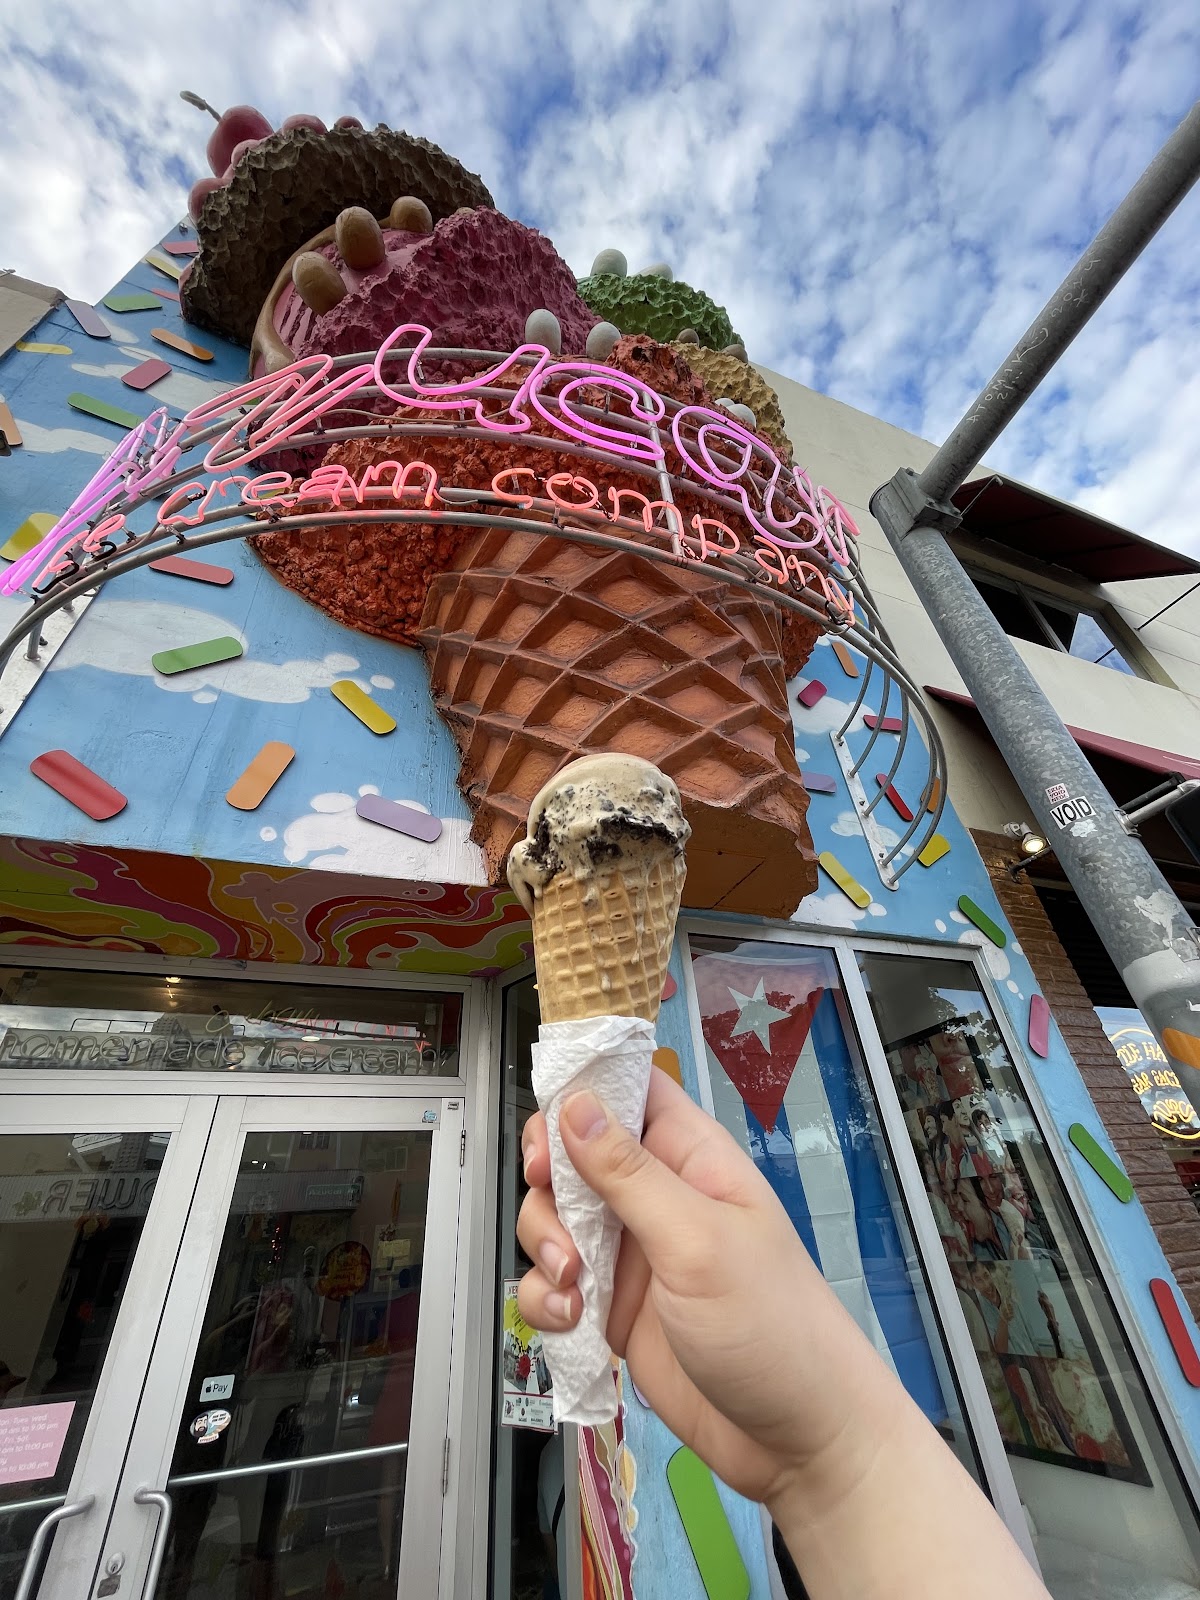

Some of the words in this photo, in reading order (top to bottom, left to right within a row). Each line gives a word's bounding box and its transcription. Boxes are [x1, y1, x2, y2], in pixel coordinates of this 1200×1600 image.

[157, 461, 438, 525] cream
[492, 468, 855, 626] company
[1051, 798, 1093, 826] VOID
[213, 1383, 229, 1393] Pay
